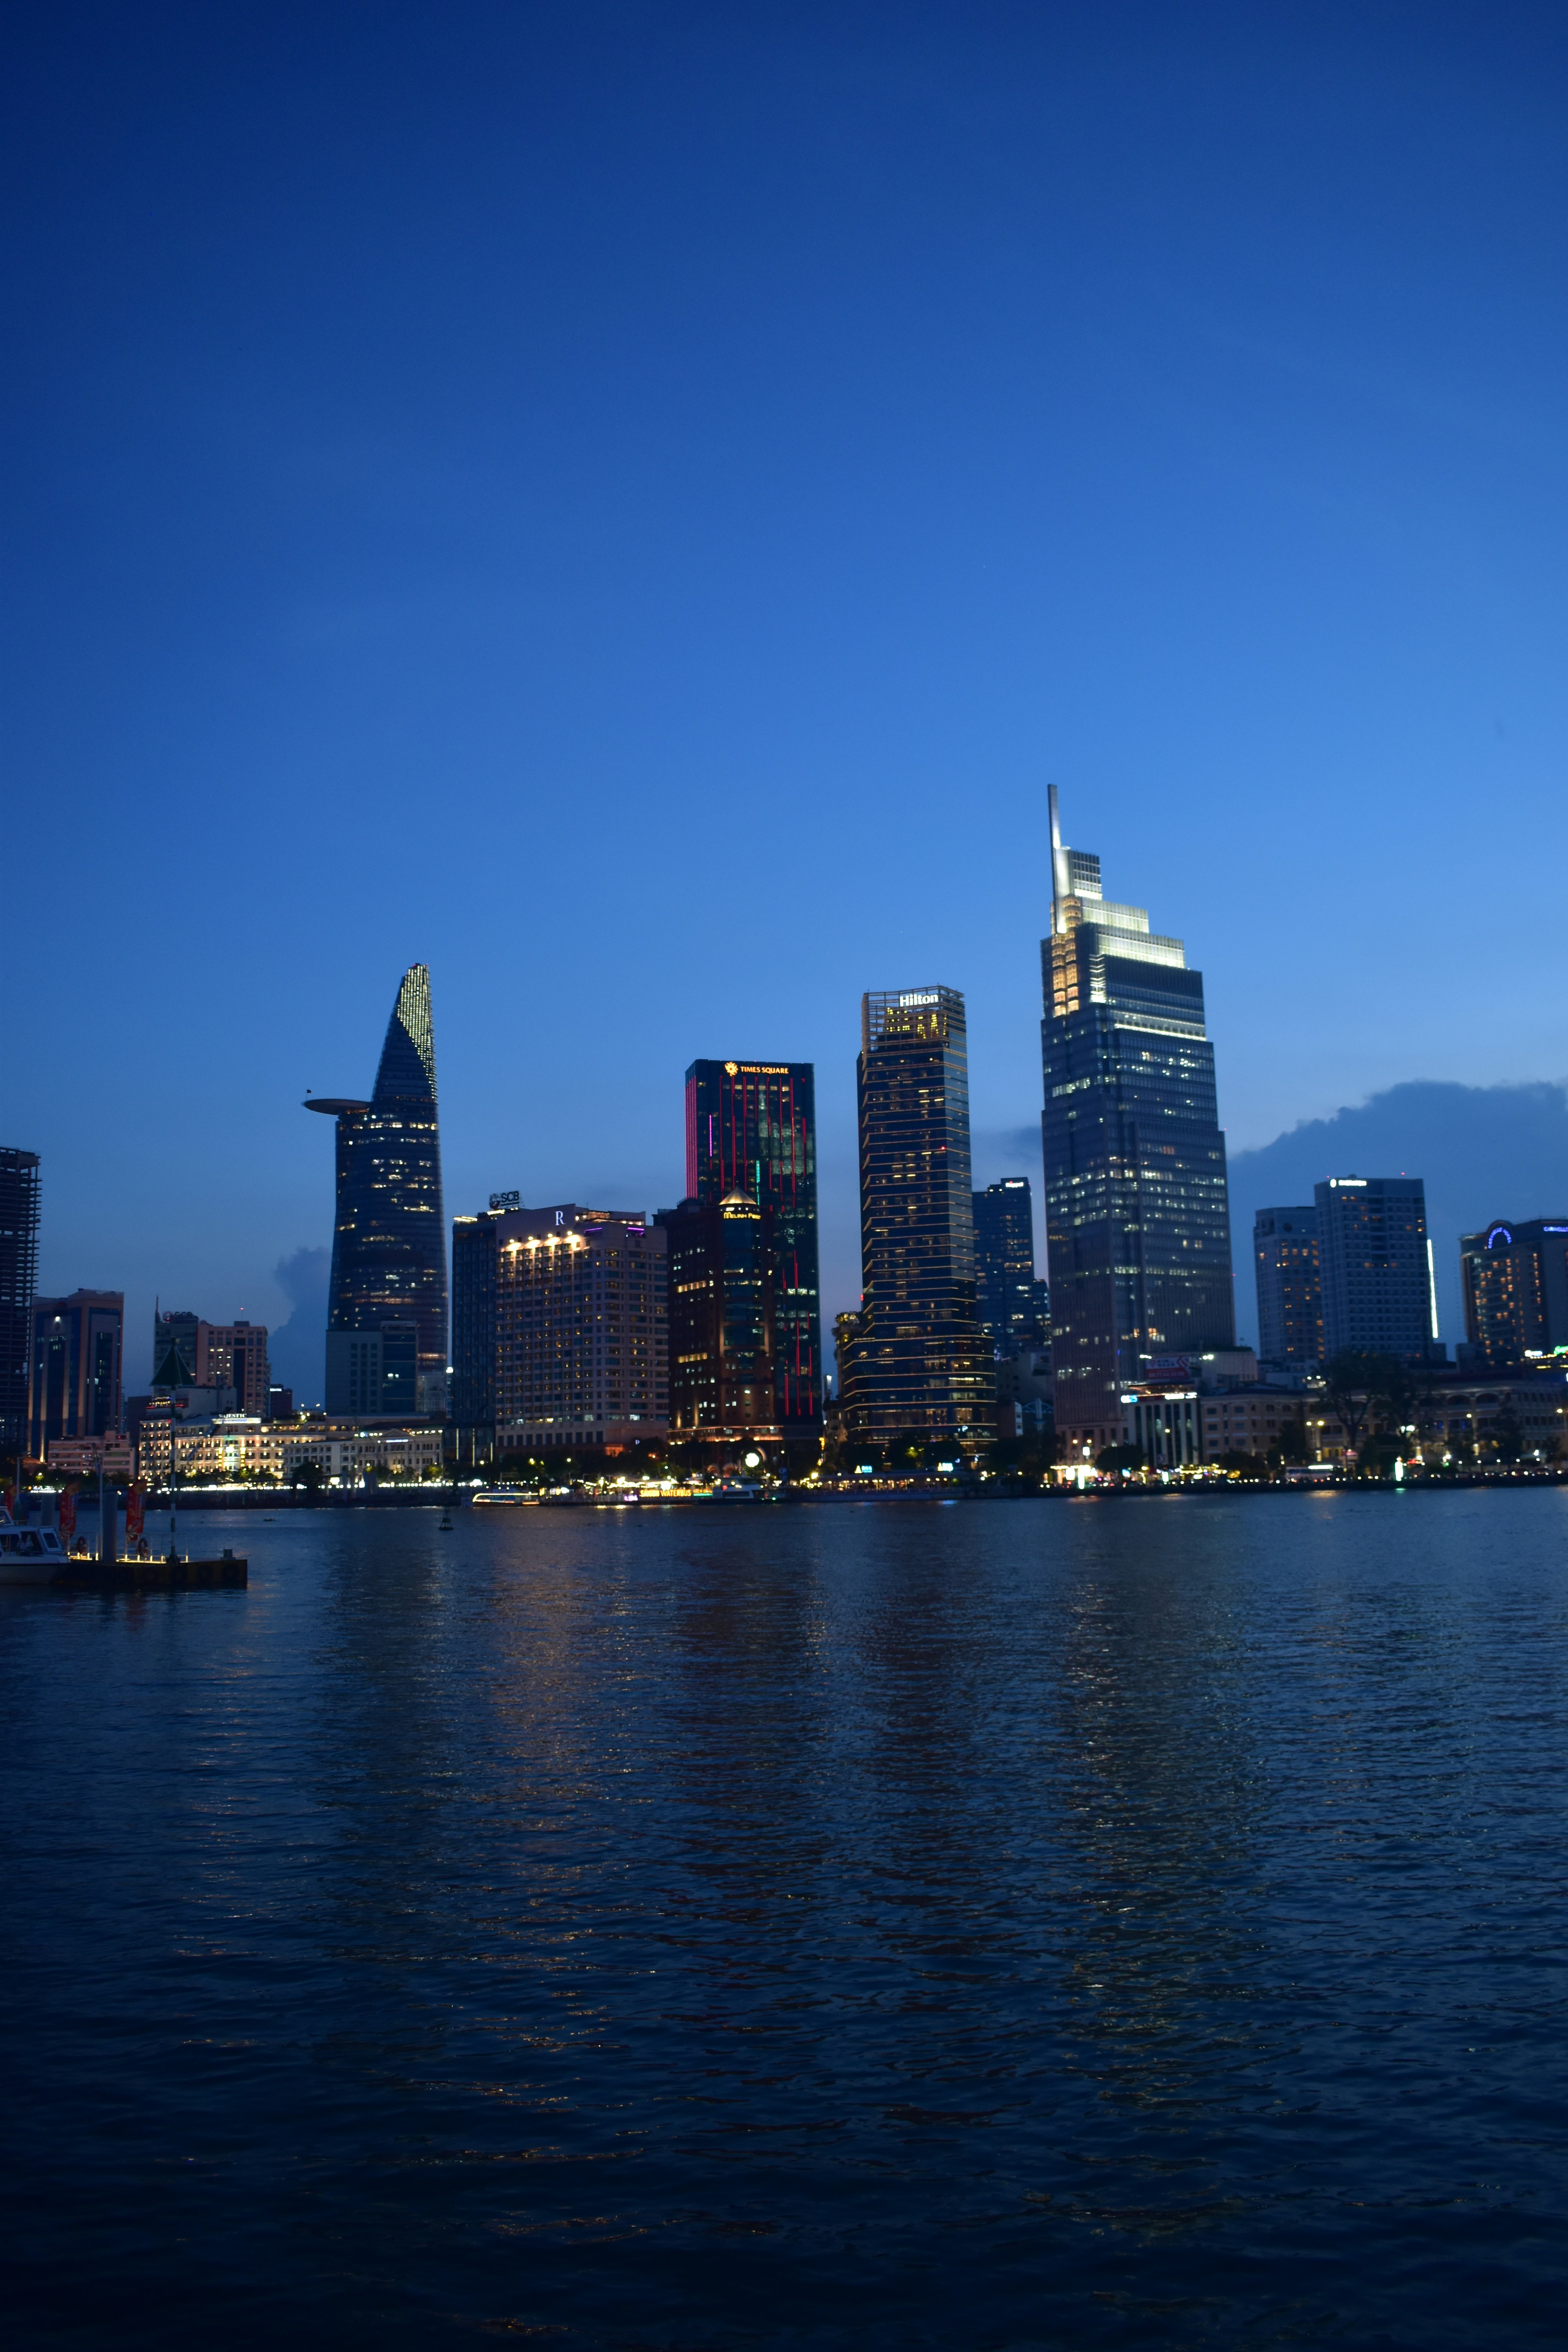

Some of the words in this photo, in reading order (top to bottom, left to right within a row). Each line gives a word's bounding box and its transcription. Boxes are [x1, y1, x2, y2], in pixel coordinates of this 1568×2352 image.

[900, 994, 938, 1007] Hilton
[501, 1191, 519, 1203] SCB
[555, 1210, 566, 1226] R
